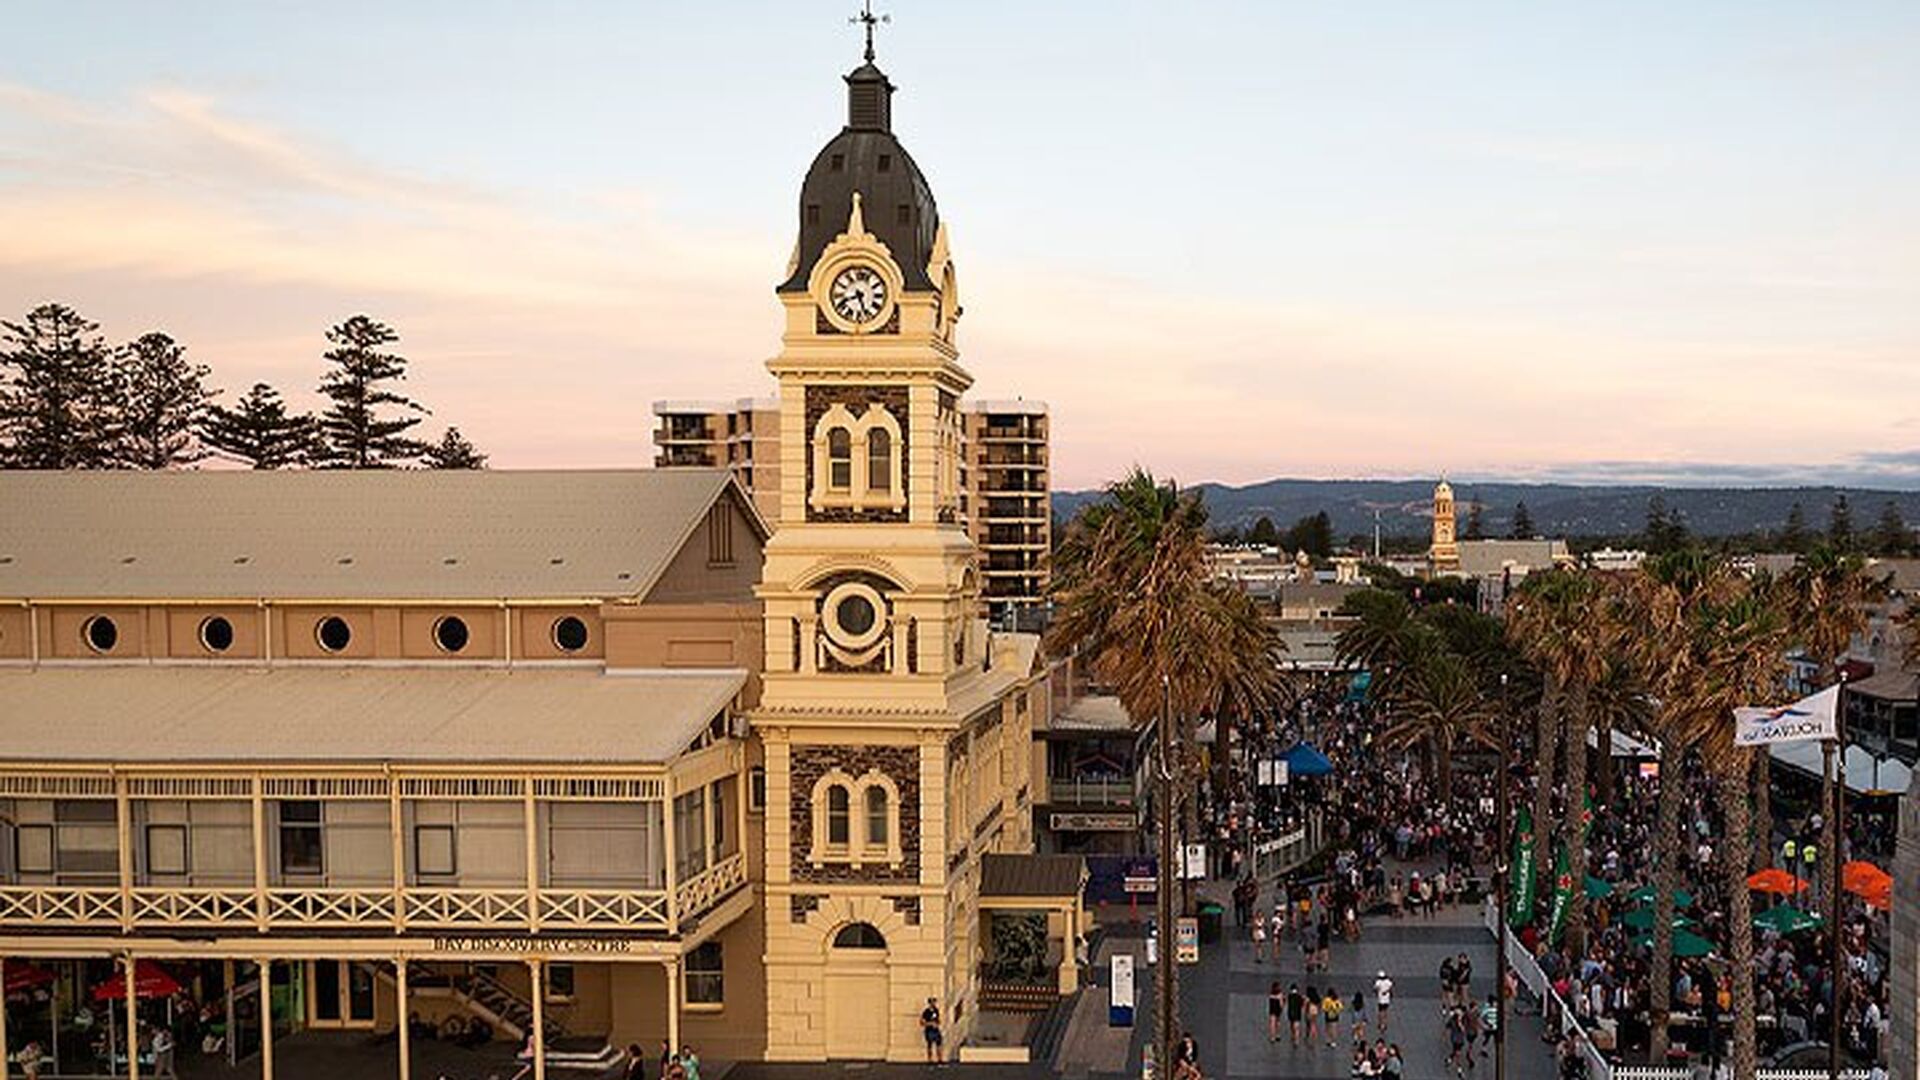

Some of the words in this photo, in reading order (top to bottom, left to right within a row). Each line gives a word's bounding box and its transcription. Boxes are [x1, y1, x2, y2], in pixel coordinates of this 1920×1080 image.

[434, 938, 464, 951] BAY
[471, 938, 560, 952] DISCOVERY
[563, 938, 631, 952] CENTRE
